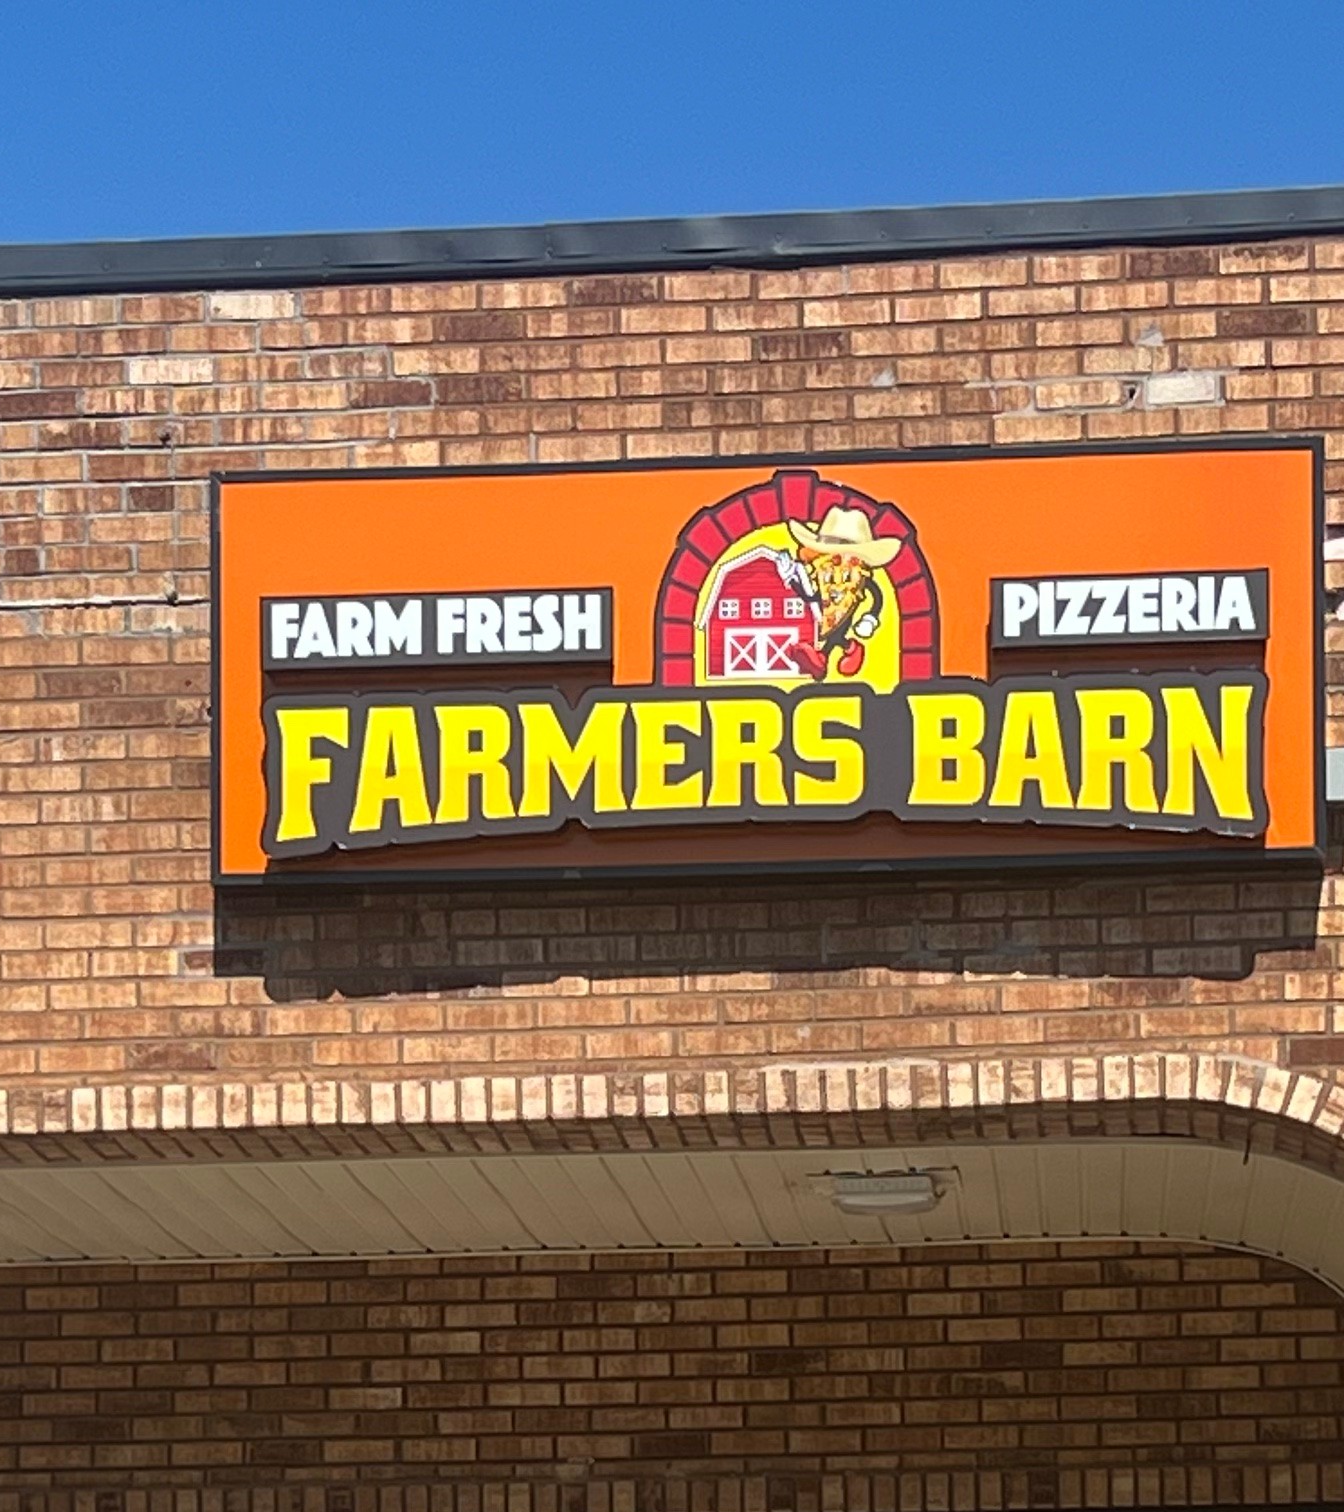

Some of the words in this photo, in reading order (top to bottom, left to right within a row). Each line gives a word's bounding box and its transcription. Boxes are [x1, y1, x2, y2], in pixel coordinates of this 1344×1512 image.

[268, 599, 422, 662] FARM
[446, 591, 603, 655] FRESH
[1002, 576, 1256, 638] PIZZERIA
[274, 697, 866, 844] FARMERS
[907, 685, 1256, 820] BARN
